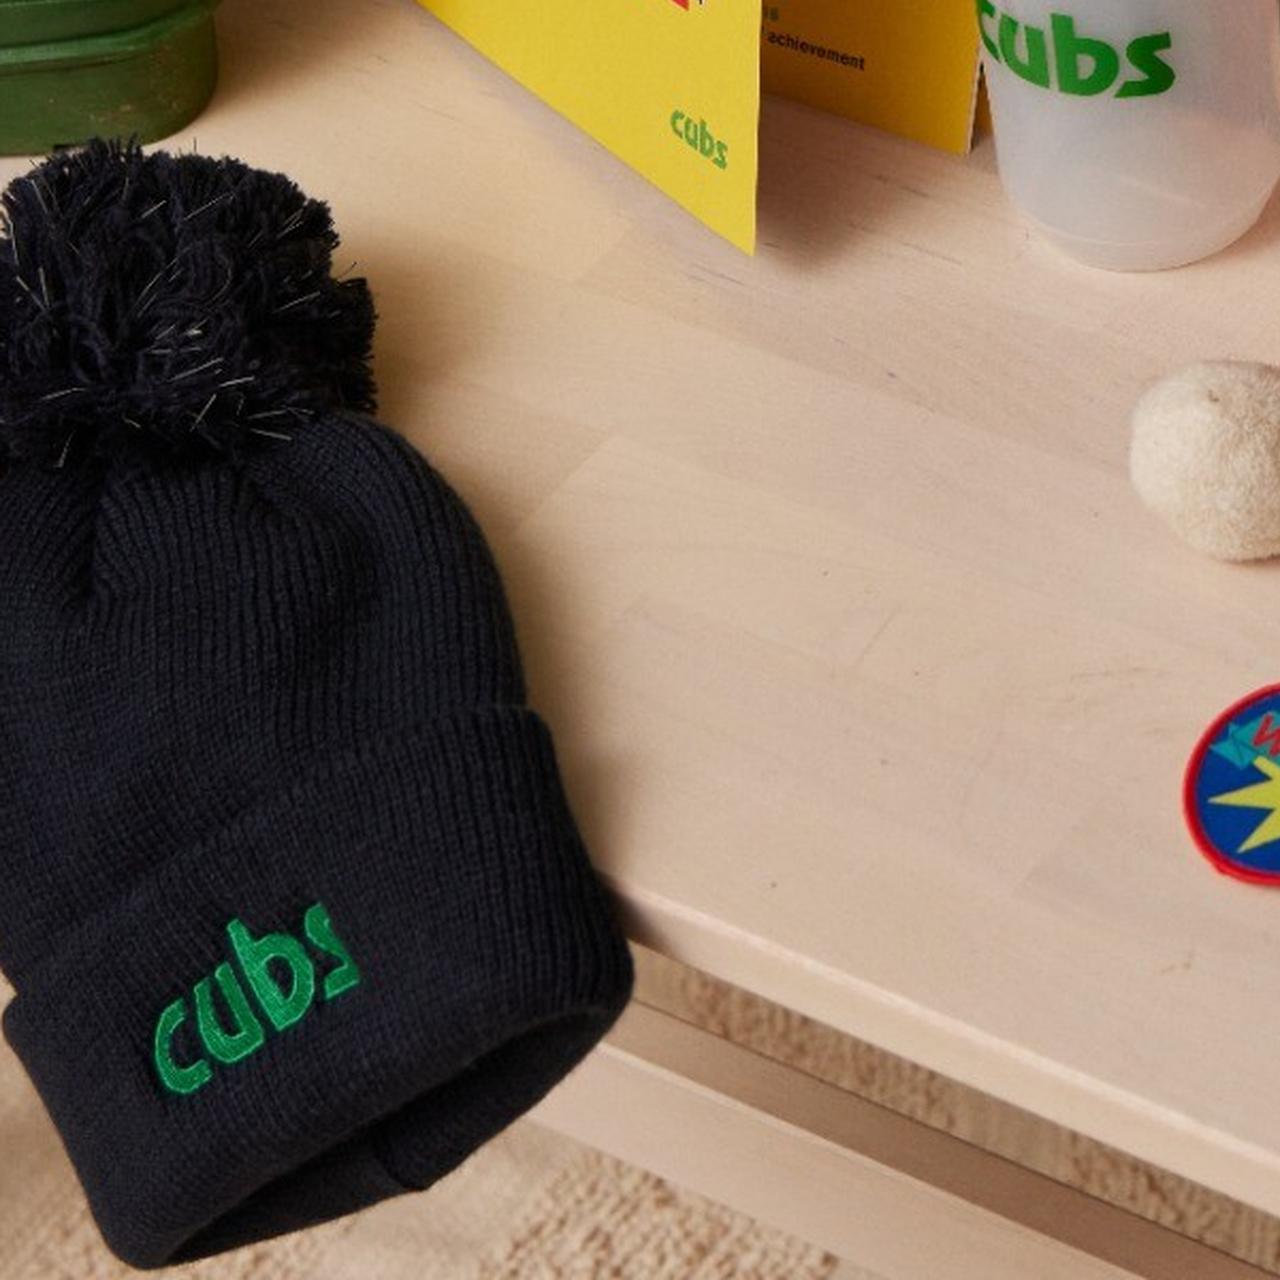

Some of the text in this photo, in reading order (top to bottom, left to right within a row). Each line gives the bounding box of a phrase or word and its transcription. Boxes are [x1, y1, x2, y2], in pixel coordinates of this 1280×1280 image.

[767, 30, 866, 71] achievement
[670, 110, 729, 171] cubs
[154, 902, 362, 1094] cubs
